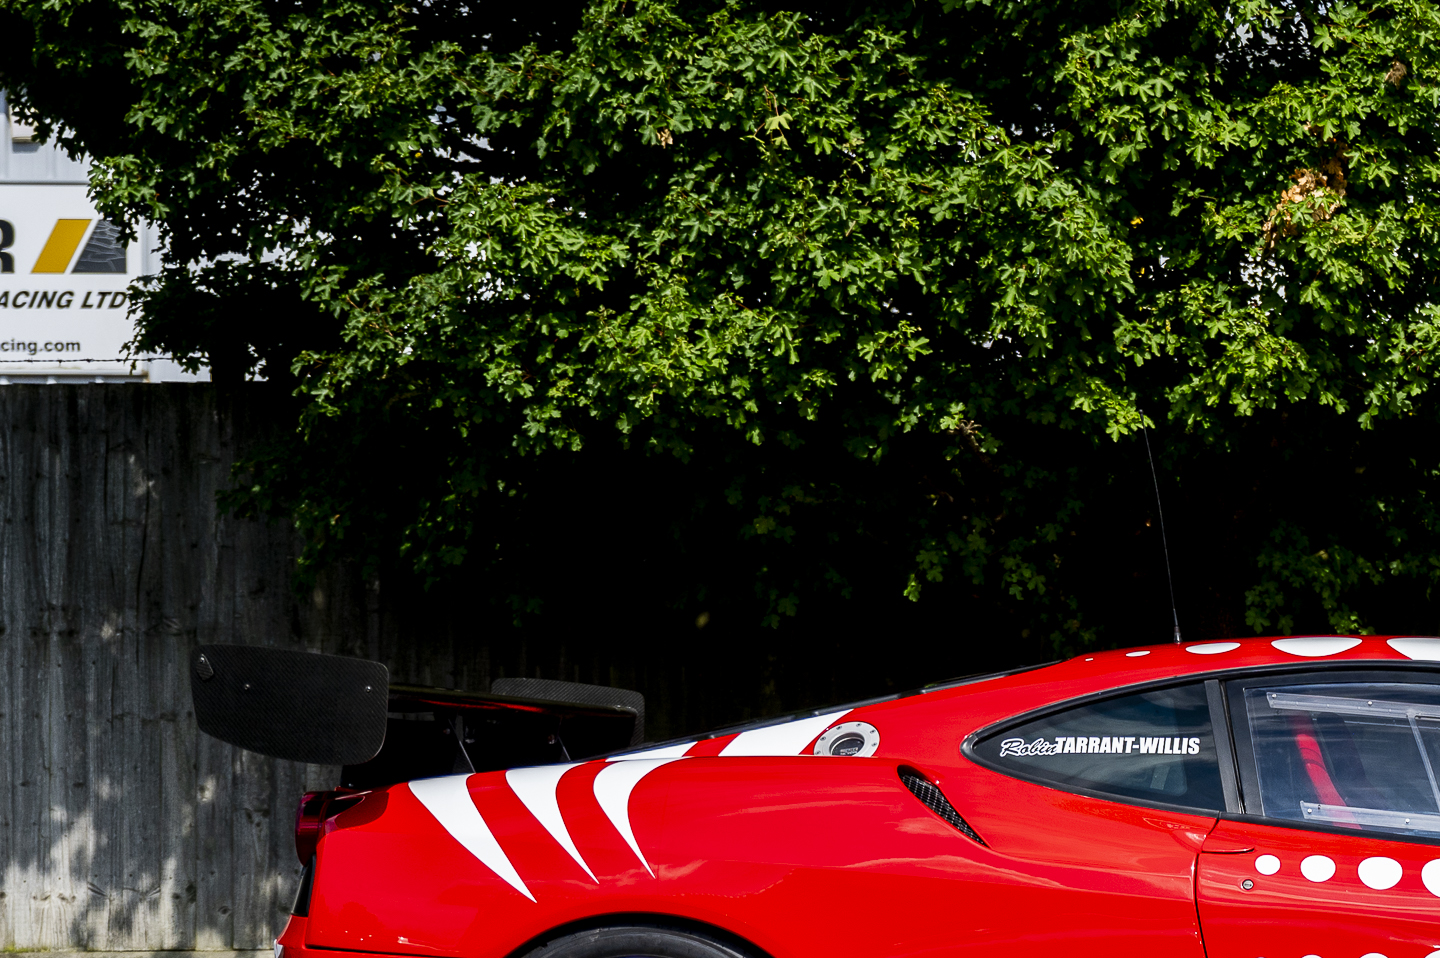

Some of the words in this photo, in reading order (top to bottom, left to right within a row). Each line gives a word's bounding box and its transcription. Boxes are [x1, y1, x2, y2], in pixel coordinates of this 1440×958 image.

[80, 291, 127, 309] LTD
[0, 339, 80, 355] cing.com
[1055, 736, 1201, 755] TARRANT-WILLIS
